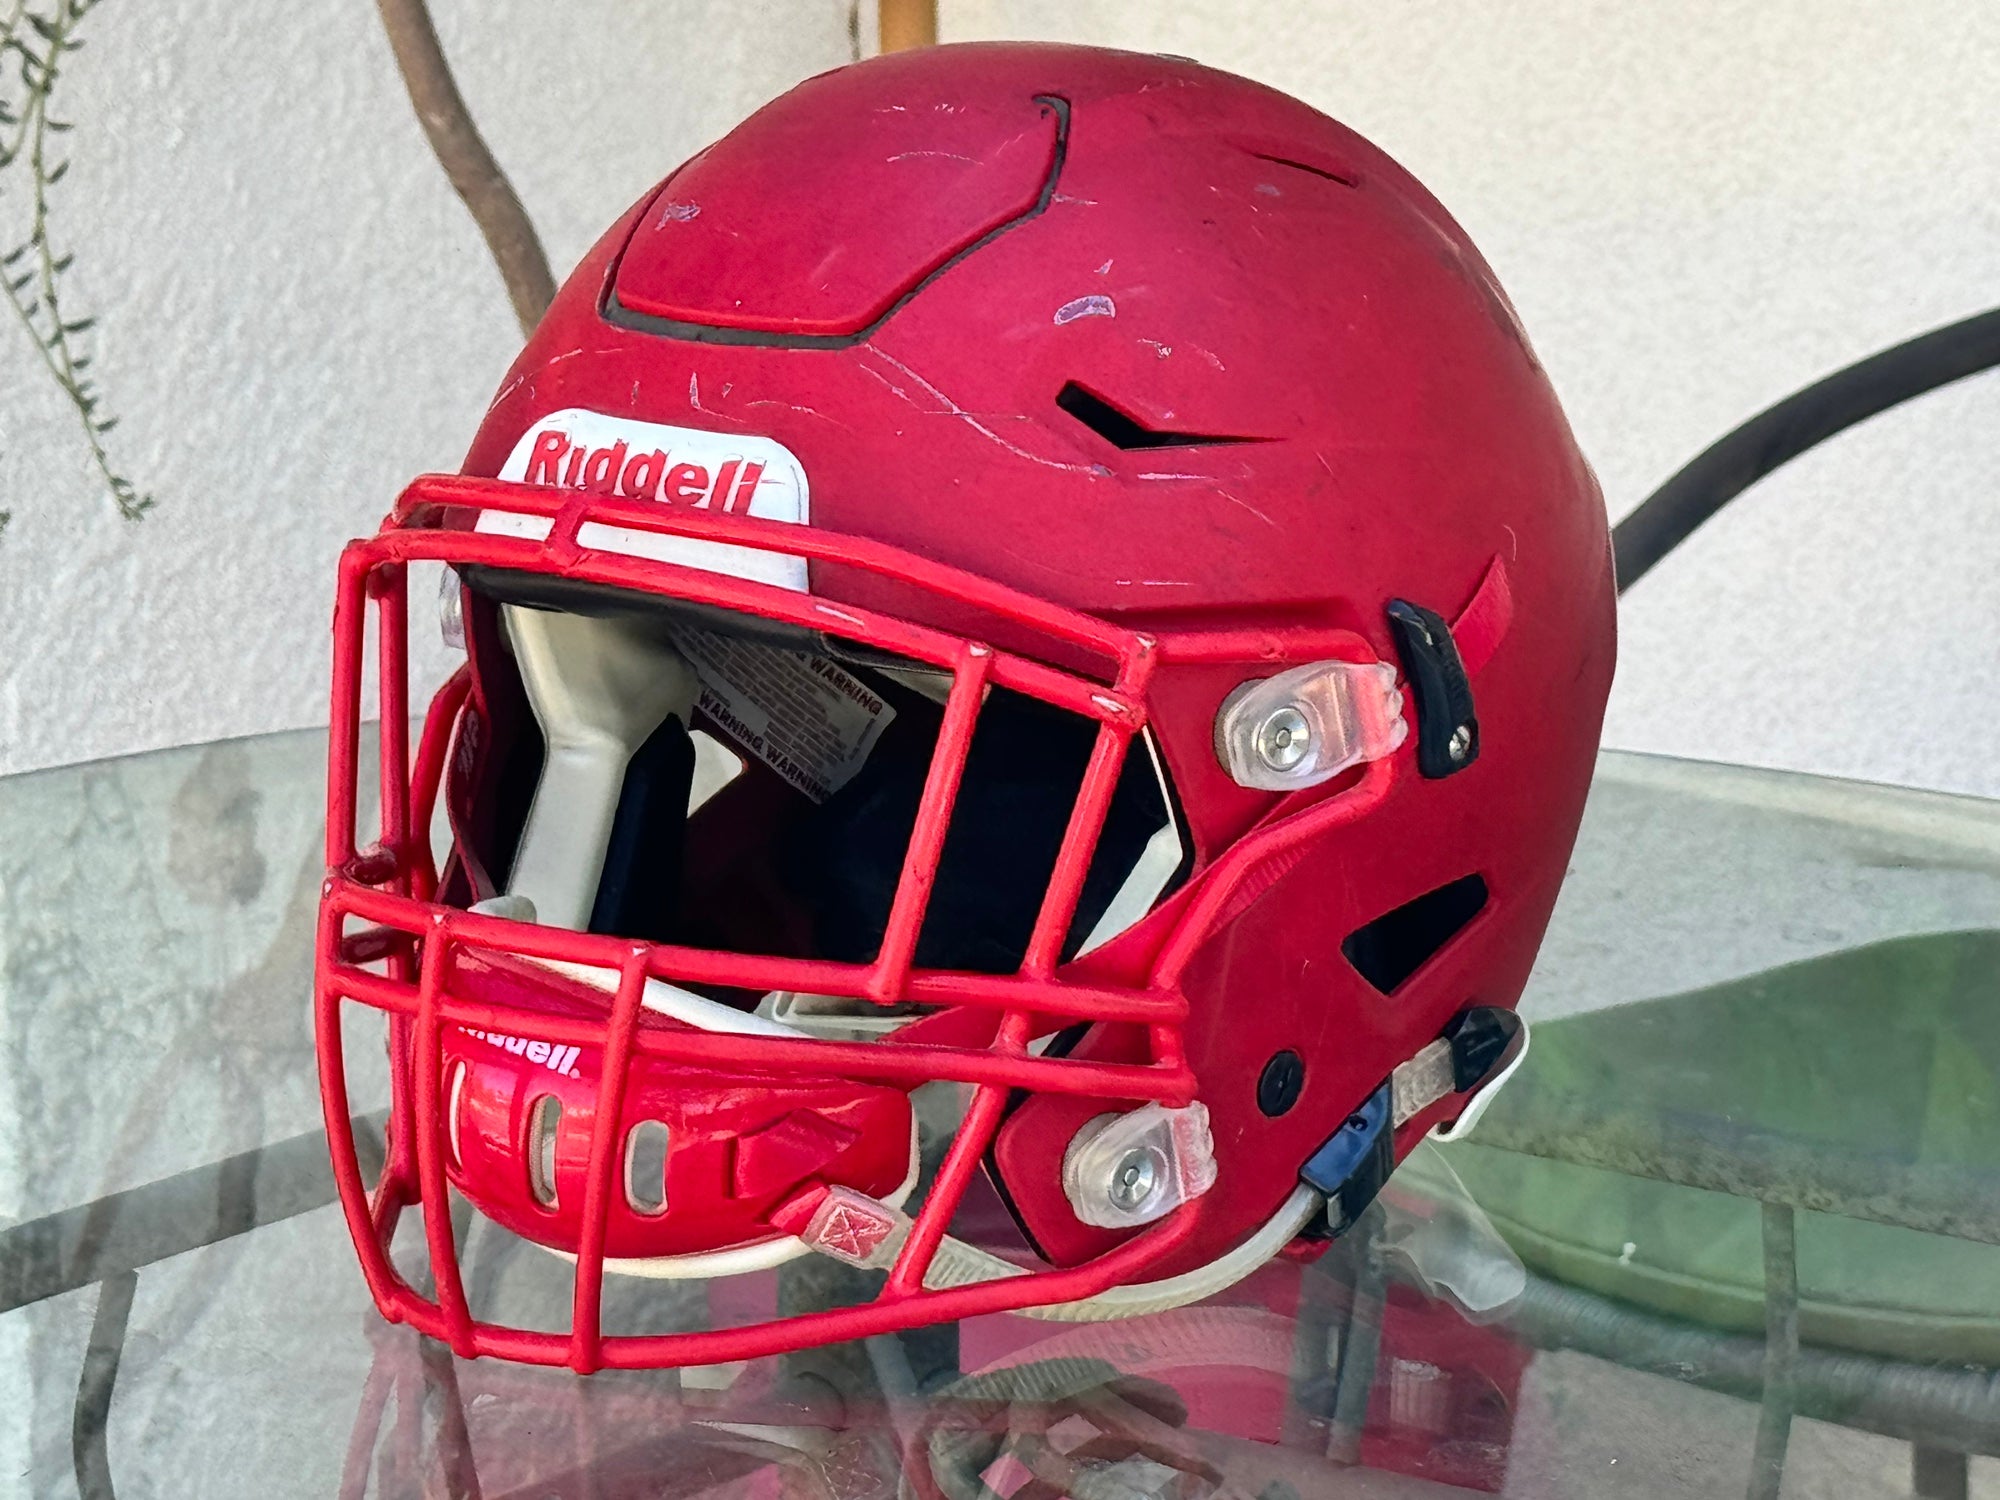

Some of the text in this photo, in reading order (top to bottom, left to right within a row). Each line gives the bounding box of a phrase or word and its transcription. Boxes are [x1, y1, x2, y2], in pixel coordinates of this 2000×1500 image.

[525, 430, 765, 515] Riddell
[810, 656, 882, 716] WARNING
[700, 689, 764, 750] WARNING
